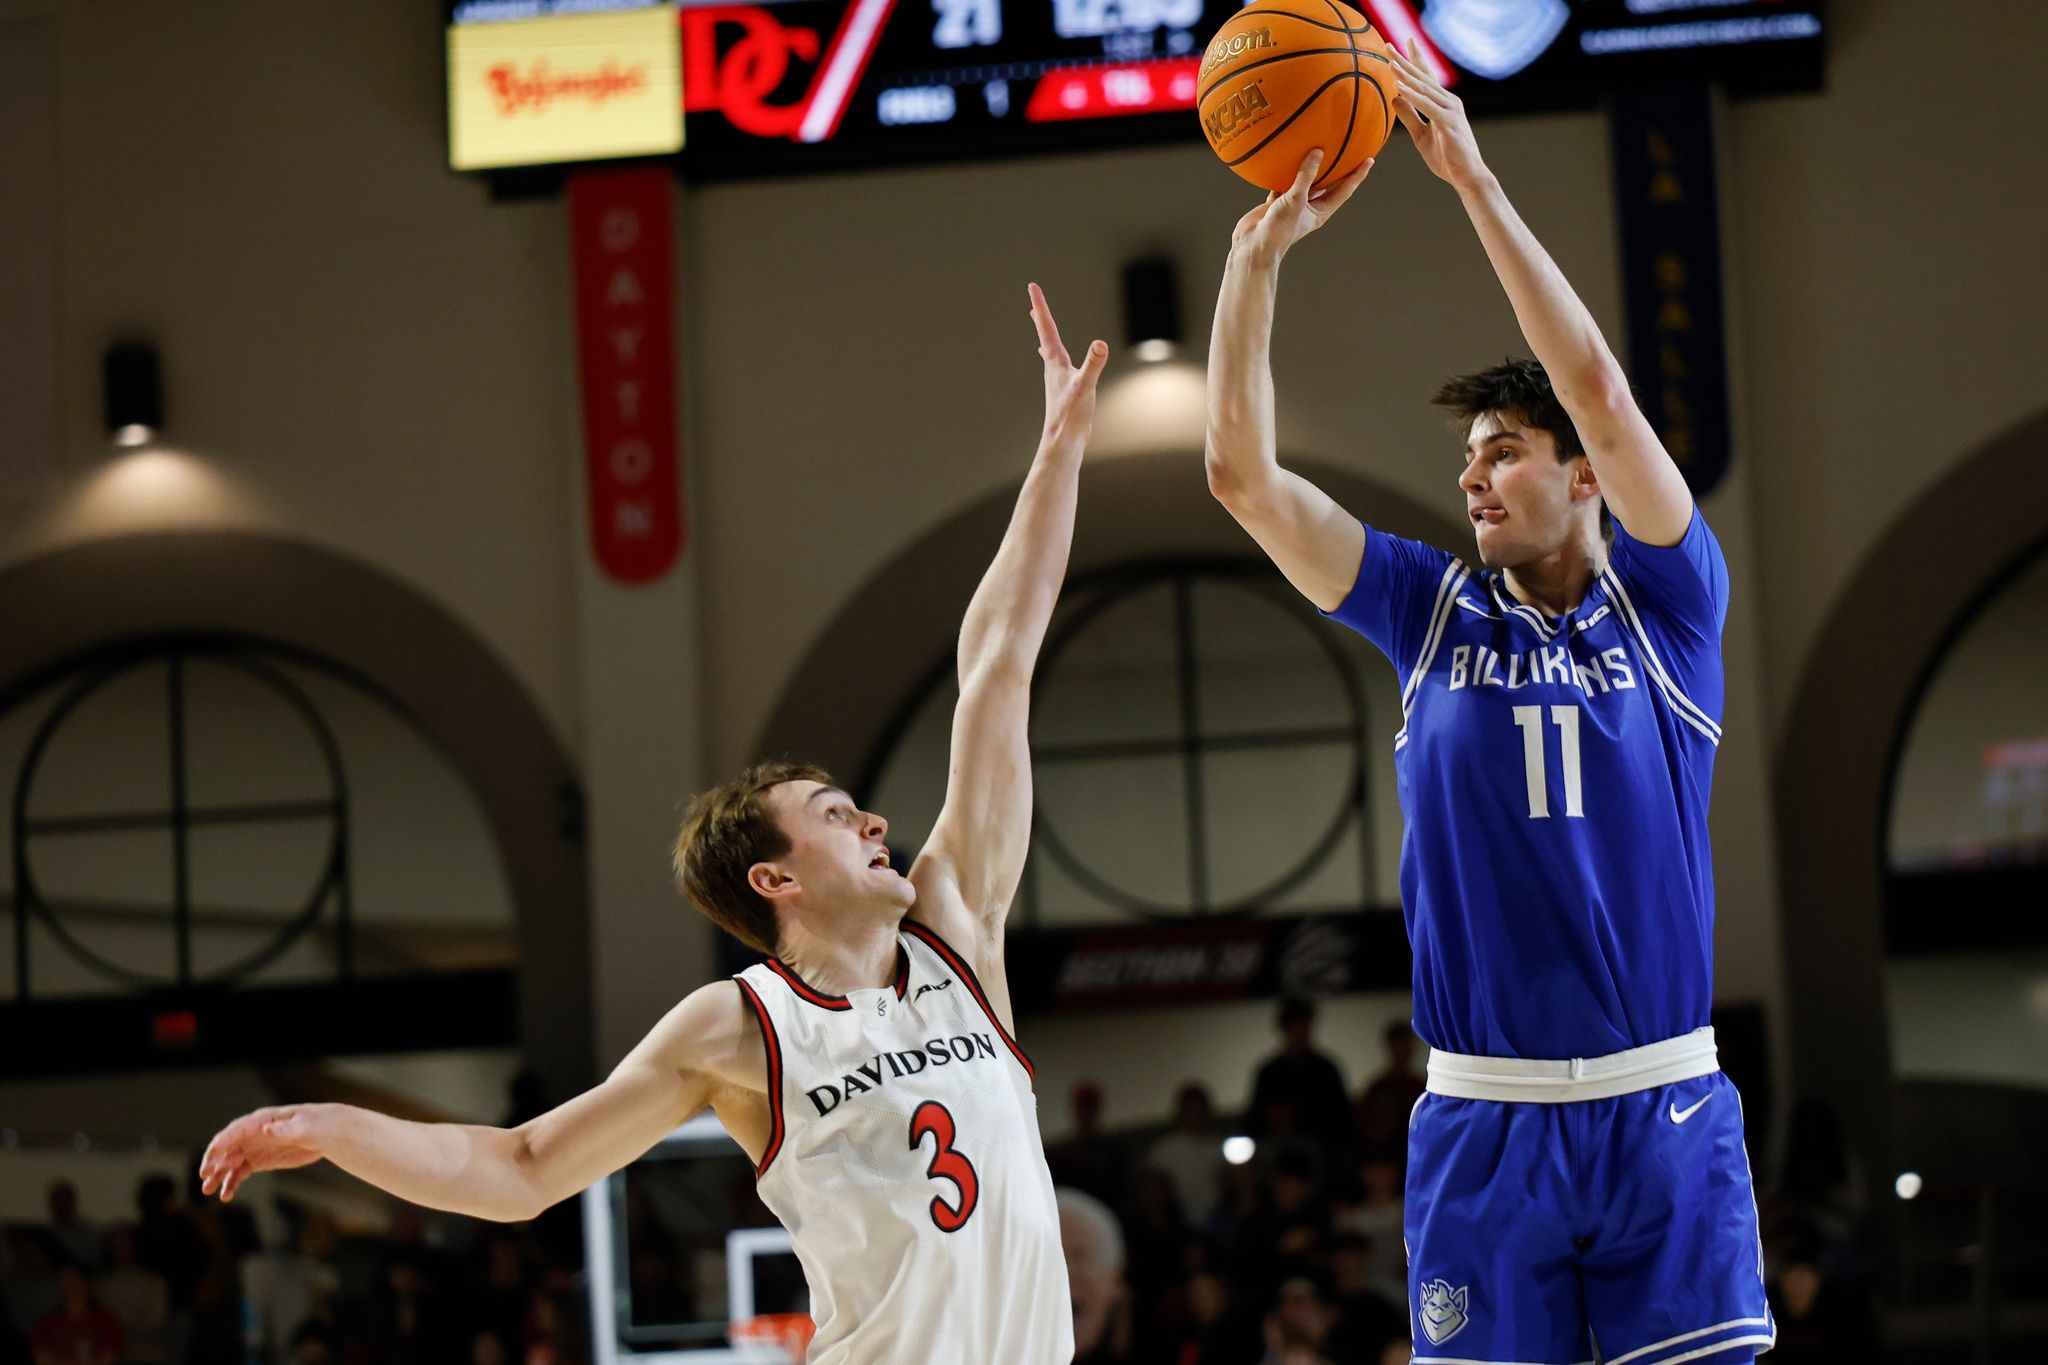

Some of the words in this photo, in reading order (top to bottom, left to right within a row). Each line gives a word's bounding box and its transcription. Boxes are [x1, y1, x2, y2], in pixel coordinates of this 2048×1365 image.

[1205, 82, 1270, 144] NCAA
[602, 208, 654, 541] DAYTON
[1512, 705, 1585, 819] 11
[806, 1032, 997, 1117] DAVIDSON
[909, 1100, 979, 1233] 3
